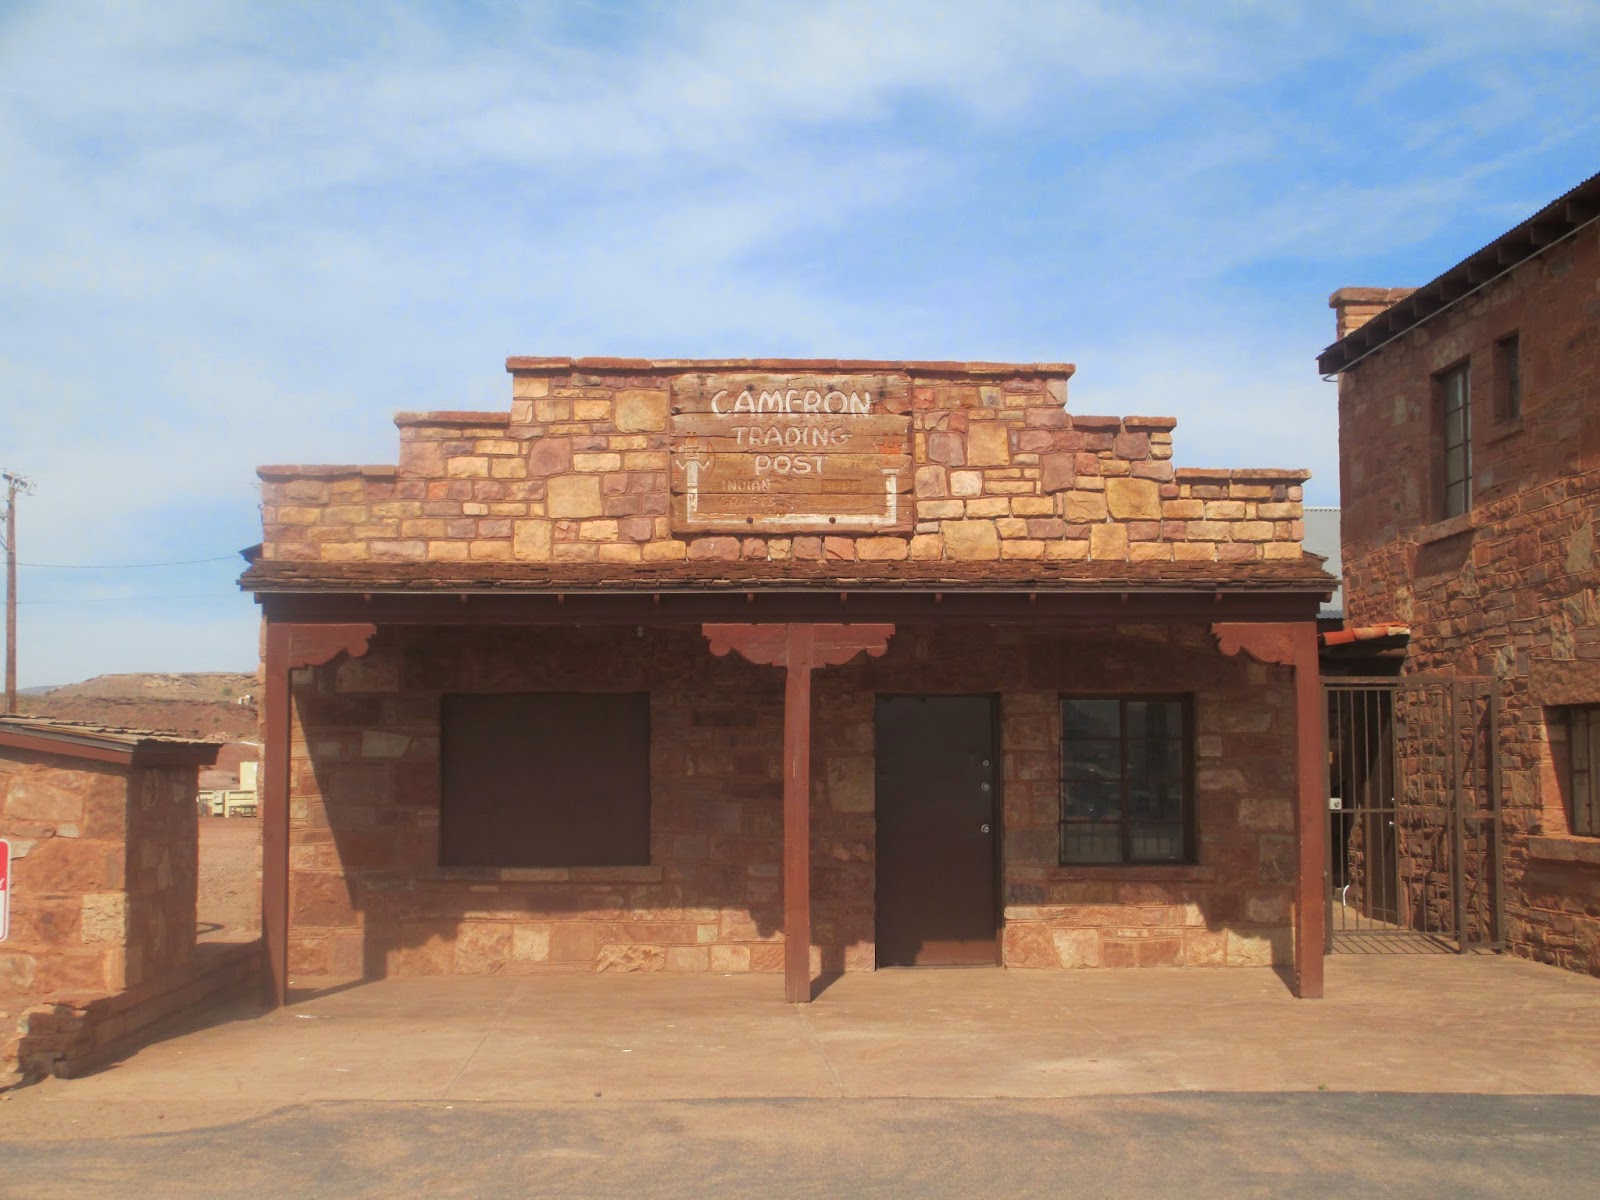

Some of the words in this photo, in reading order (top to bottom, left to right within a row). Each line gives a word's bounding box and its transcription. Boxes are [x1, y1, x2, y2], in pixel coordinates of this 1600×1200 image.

[710, 389, 872, 418] CAMERON
[731, 425, 852, 447] TRADING
[754, 454, 829, 475] POST
